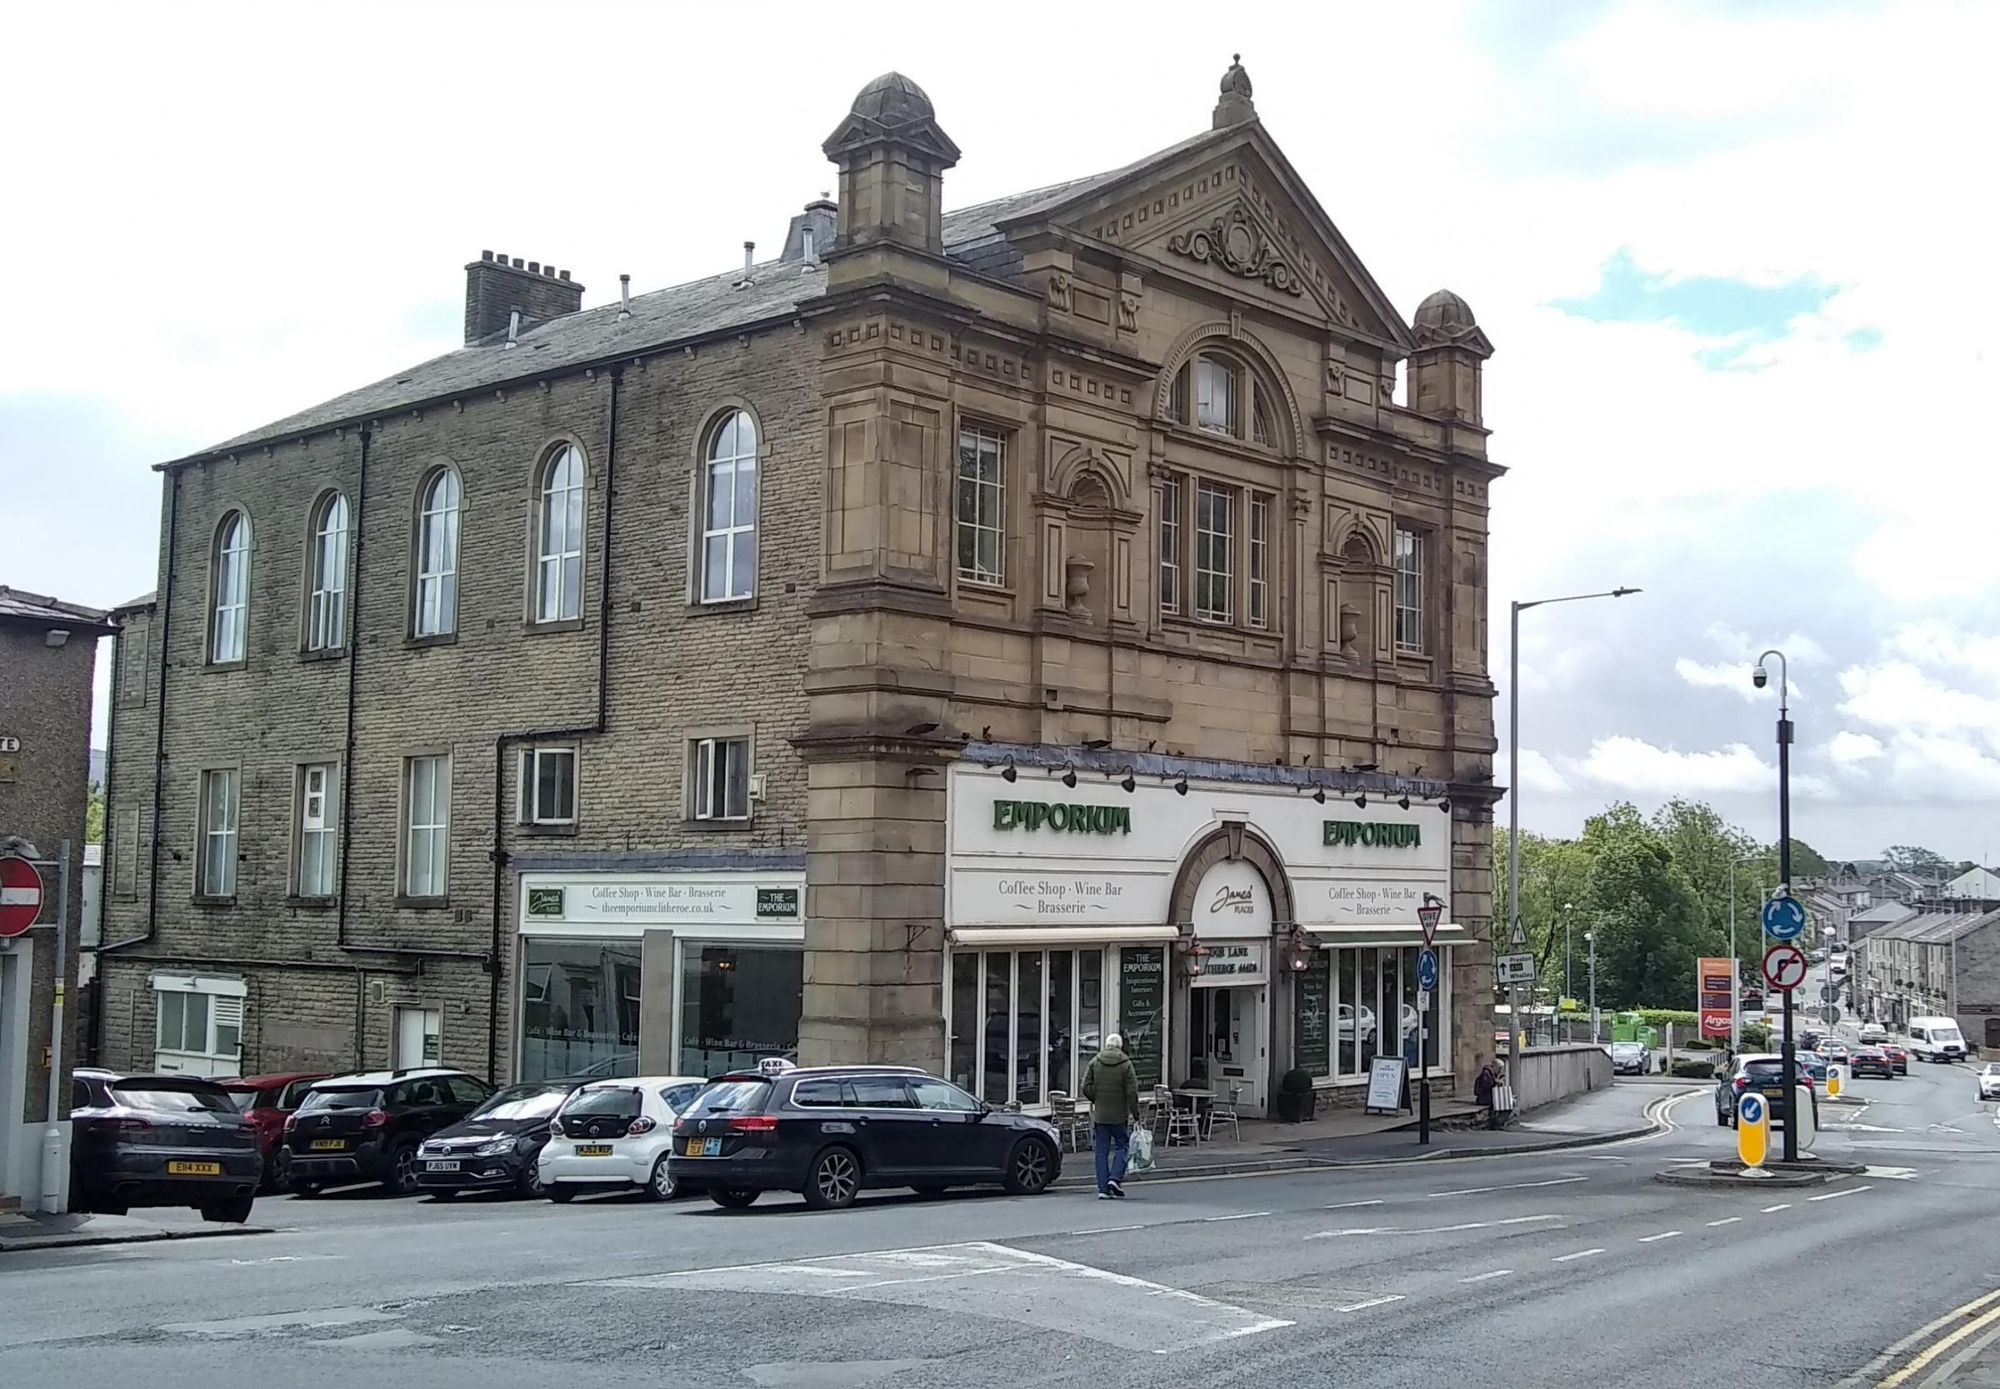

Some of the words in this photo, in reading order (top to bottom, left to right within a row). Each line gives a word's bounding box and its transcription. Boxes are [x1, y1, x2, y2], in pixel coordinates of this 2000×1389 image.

[993, 800, 1131, 835] EMPORIUM
[1323, 820, 1421, 848] EMPORIUM
[592, 886, 618, 898] Coffee
[620, 886, 640, 901] Shop
[645, 886, 666, 898] Wine
[668, 887, 682, 898] Bar
[689, 887, 726, 898] Brasserie
[999, 881, 1035, 895] Coffee
[1038, 881, 1066, 899] Shop
[1075, 881, 1102, 895] Wine
[1105, 882, 1123, 896] Bar
[1329, 887, 1355, 900] Coffee
[1356, 887, 1377, 903] Shop
[1382, 887, 1403, 900] Wine
[1403, 887, 1416, 900] Bar
[770, 893, 784, 902] THE
[602, 902, 714, 916] theemporiumclitheroe.co.uk
[758, 902, 796, 912] EMPORIUM
[1038, 900, 1086, 914] Brasserie
[1356, 903, 1391, 915] Brasserie
[1422, 912, 1436, 921] GIVE
[1136, 953, 1150, 962] THE
[1228, 946, 1249, 958] LANE
[1123, 962, 1161, 972] EMPORIUM
[1704, 1015, 1732, 1027] Argos
[705, 1037, 723, 1047] Wine
[724, 1038, 738, 1048] Bar
[761, 1060, 782, 1070] TAXI
[195, 1164, 213, 1173] XXX
